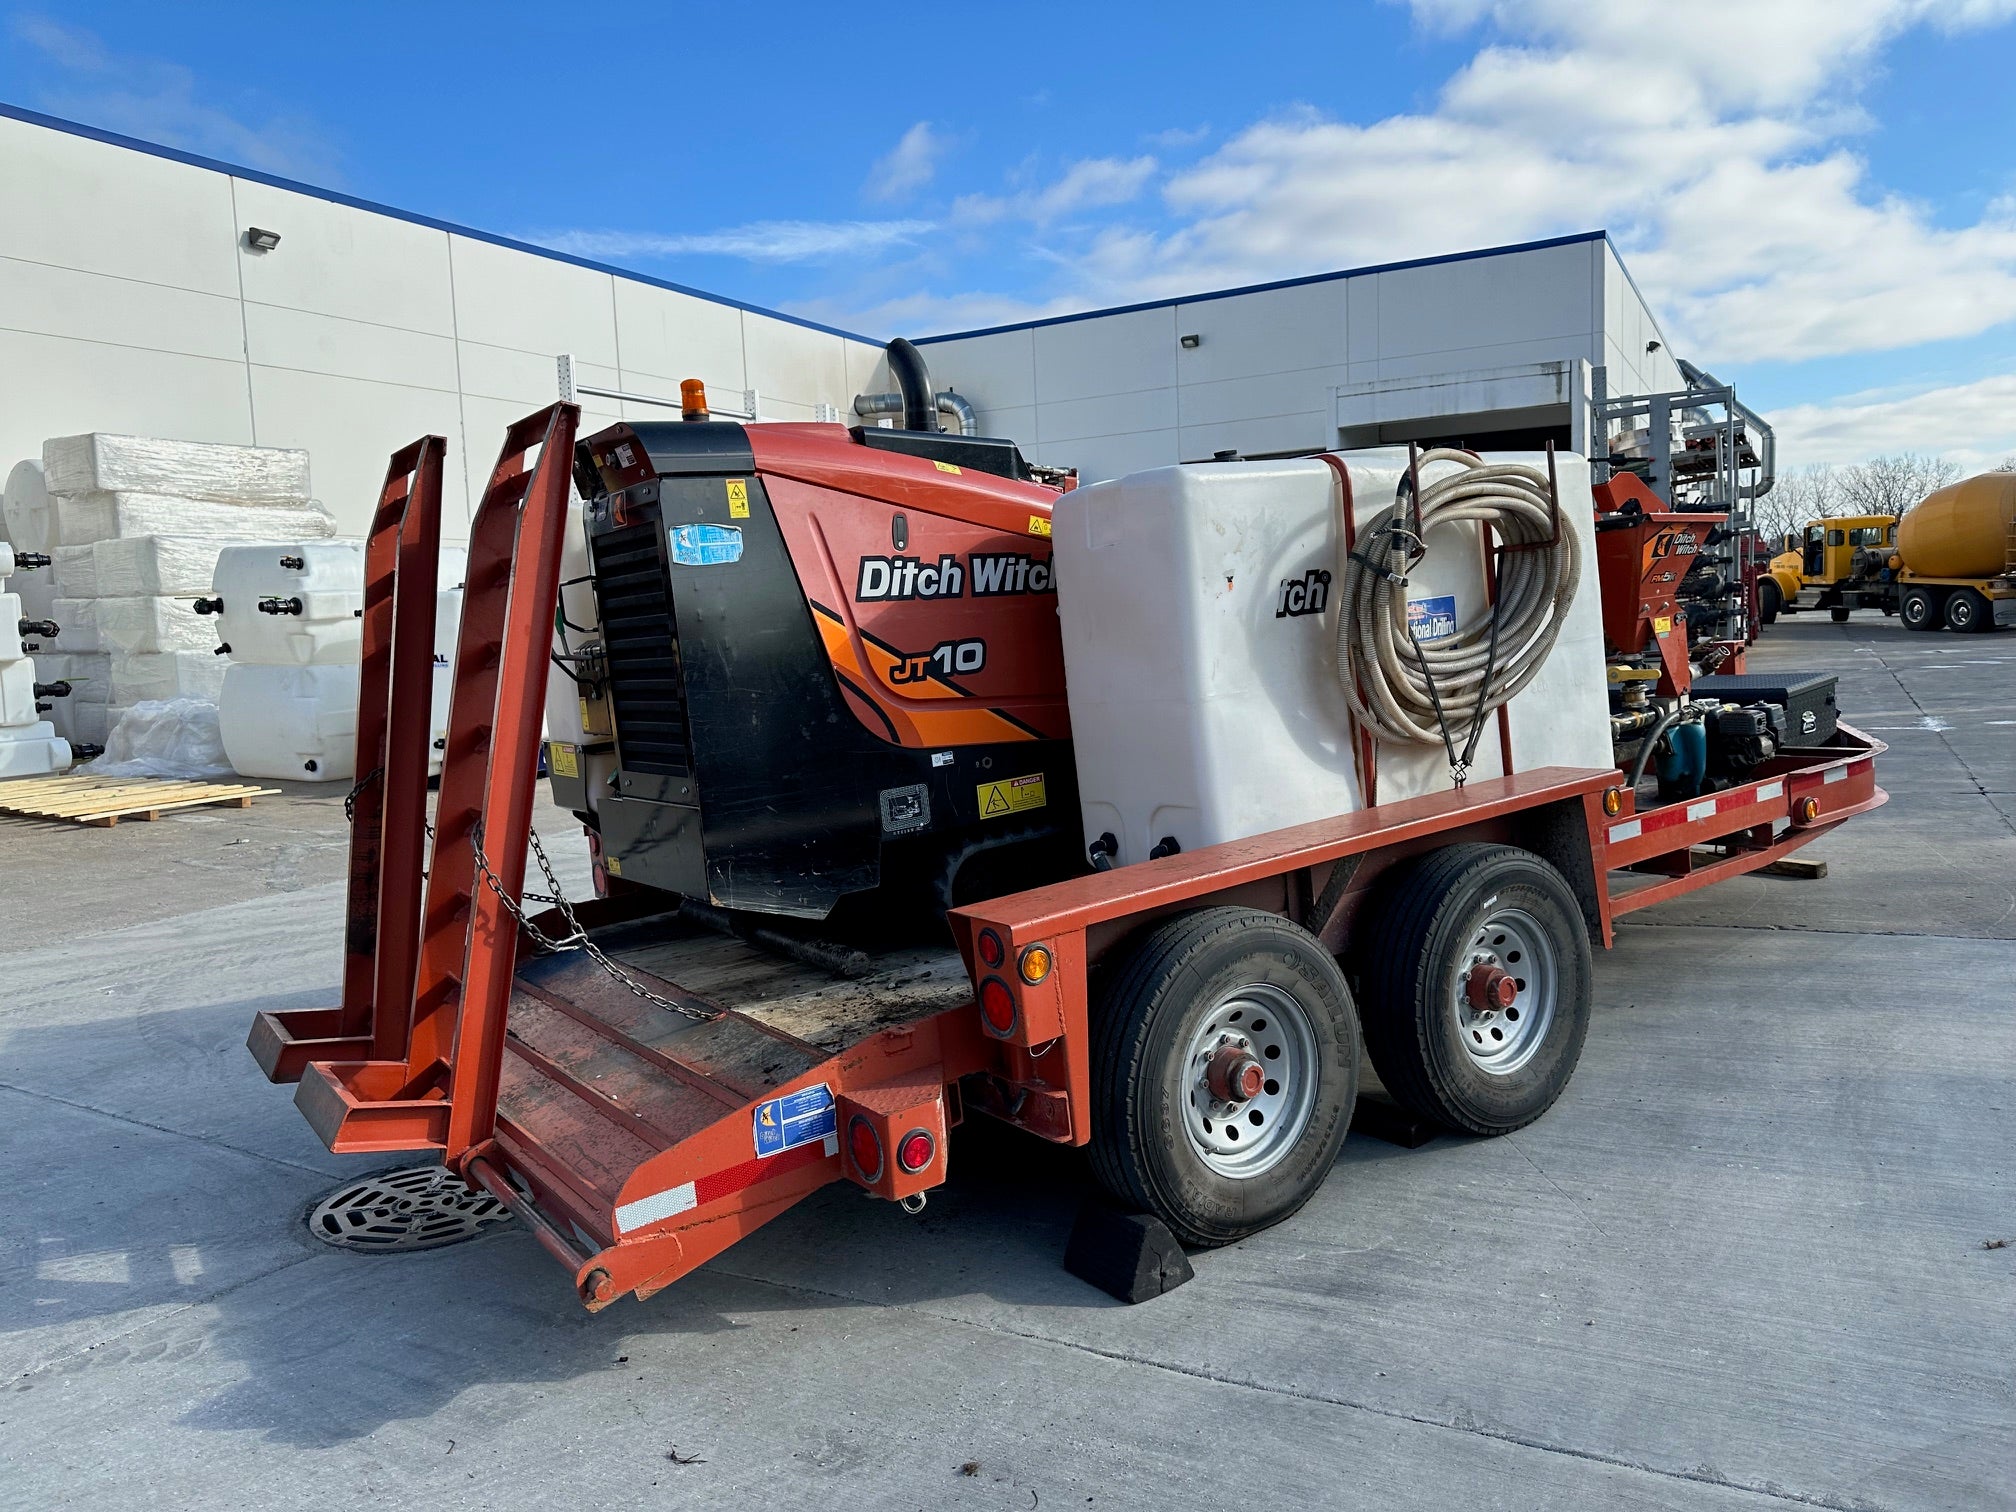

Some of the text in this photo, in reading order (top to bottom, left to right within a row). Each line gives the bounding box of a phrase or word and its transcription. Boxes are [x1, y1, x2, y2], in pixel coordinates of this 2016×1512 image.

[1674, 533, 1696, 545] Ditch
[1675, 544, 1698, 555] Witch
[859, 556, 964, 600] Ditch
